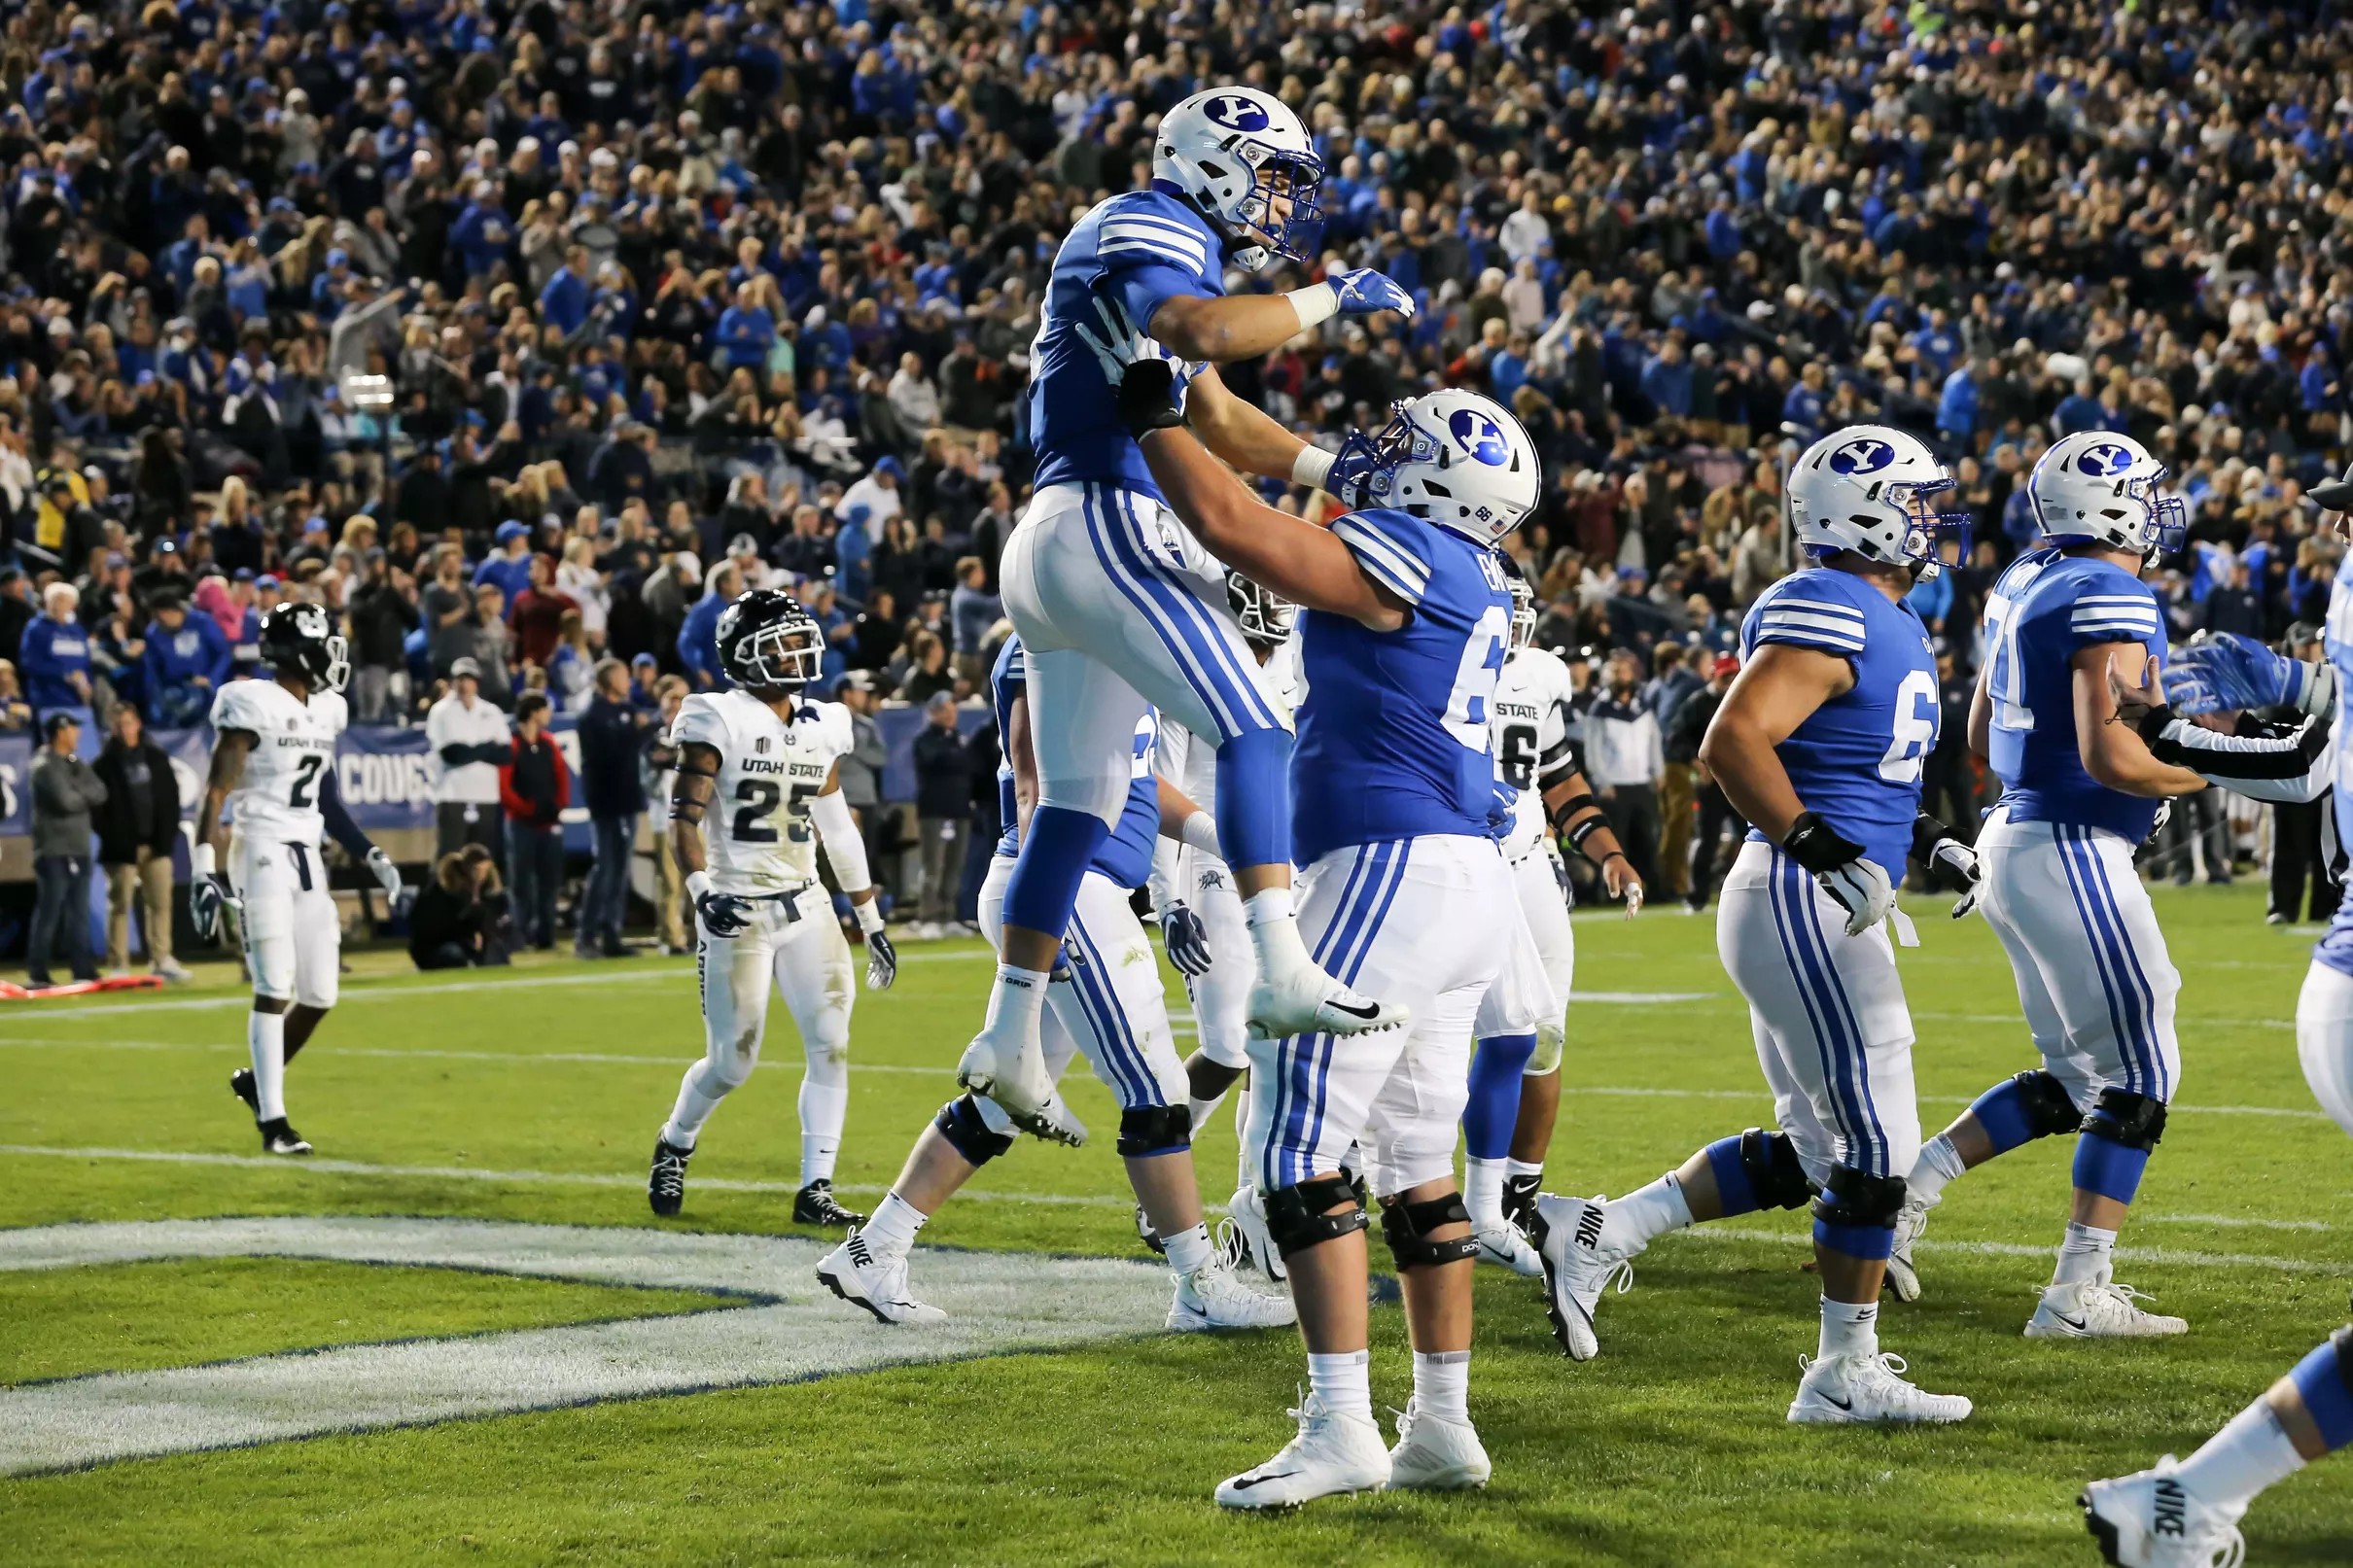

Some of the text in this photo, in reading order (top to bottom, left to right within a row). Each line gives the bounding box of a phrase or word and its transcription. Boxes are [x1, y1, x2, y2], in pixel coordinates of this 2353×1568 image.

[1218, 96, 1263, 126] Y
[1837, 441, 1883, 471] Y
[2083, 445, 2123, 473] Y
[1474, 505, 1493, 523] 66
[1438, 605, 1511, 755] 6
[1496, 702, 1539, 720] STATE
[1878, 669, 1942, 784] 6
[742, 757, 825, 778] UTAH STATE
[1489, 724, 1539, 791] 6
[290, 754, 323, 808] 2
[732, 778, 822, 843] 25
[1573, 1203, 1604, 1251] NIKE
[846, 1235, 874, 1269] NIKE
[2155, 1478, 2186, 1538] NIKE
